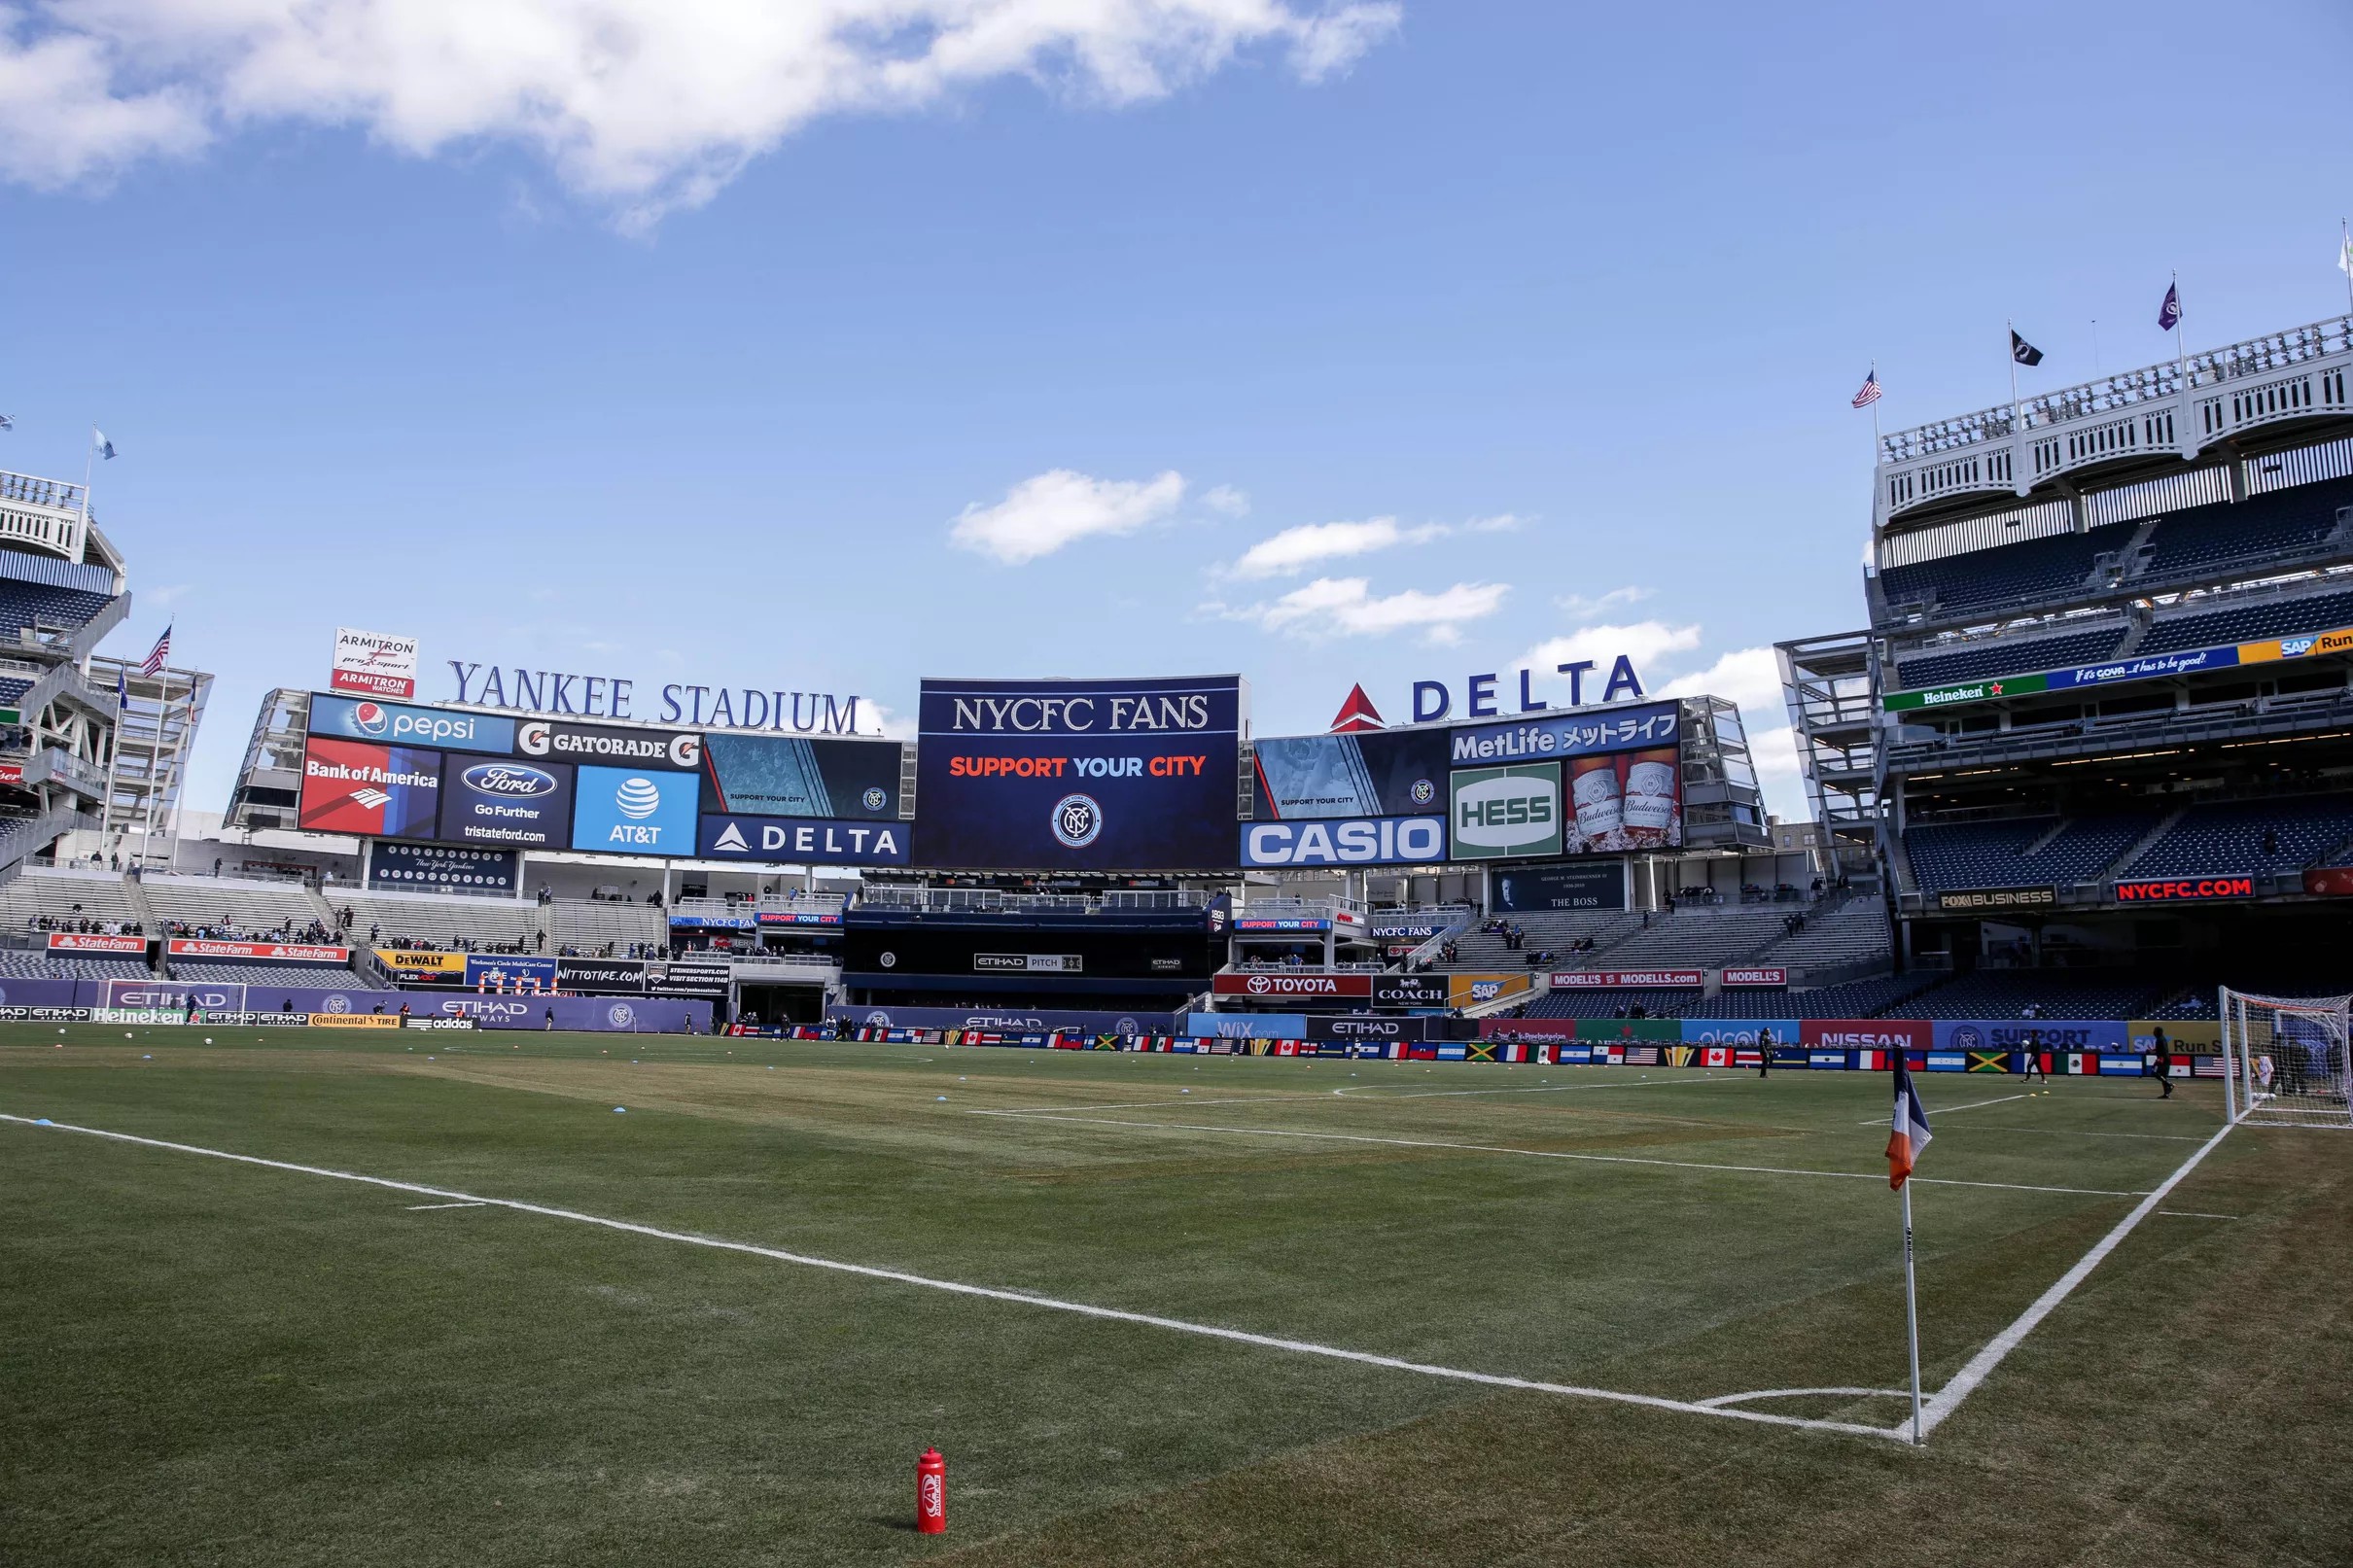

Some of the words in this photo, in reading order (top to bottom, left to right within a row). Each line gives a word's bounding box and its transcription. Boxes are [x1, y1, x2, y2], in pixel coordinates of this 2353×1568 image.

[340, 636, 413, 653] ARMITRON
[2281, 640, 2311, 655] SAP
[2322, 636, 2353, 648] Run
[2140, 660, 2156, 672] has
[2158, 661, 2166, 670] to
[2167, 656, 2177, 668] be
[339, 673, 405, 688] ARMITRON
[1413, 654, 1643, 722] DELTA
[372, 684, 404, 694] WATCHES
[1923, 684, 1983, 705] Heineken
[447, 660, 633, 719] YANKEE
[660, 683, 860, 735] STADIUM
[953, 698, 1094, 730] NYCFC
[1109, 695, 1209, 729] FANS
[393, 714, 474, 742] pepsi
[1563, 714, 1676, 749] メットライフ
[553, 734, 666, 758] GATORADE
[1453, 727, 1556, 760] MetLife
[949, 756, 1068, 778] SUPPORT
[1072, 757, 1142, 778] YOUR
[1149, 755, 1206, 776] CITY
[306, 761, 351, 780] Bank
[352, 769, 369, 782] of
[369, 768, 438, 788] America
[480, 768, 537, 794] Ford
[730, 793, 763, 802] SUPPORT
[1337, 796, 1353, 805] CITY
[474, 804, 493, 816] Go
[495, 806, 540, 819] Further
[1461, 795, 1551, 827] HESS
[465, 826, 545, 843] tristateford.com
[610, 825, 661, 844] AT&T
[762, 826, 897, 854] DELTA
[1248, 819, 1441, 863] CASIO
[447, 861, 474, 871] Yankees
[2119, 879, 2252, 900] NYCFC.COM
[1551, 898, 1570, 907] THE
[1573, 897, 1598, 906] BOSS
[1972, 891, 2053, 905] BUSINESS
[702, 918, 736, 926] NYCFC
[1373, 927, 1406, 936] NYCFC
[1408, 926, 1432, 936] FANS
[977, 958, 1024, 966] ETIHAD
[1032, 958, 1058, 967] PITCH
[557, 967, 643, 984] NITTOTIRE.COM
[1555, 975, 1601, 985] MODELL'S
[1620, 973, 1697, 984] MODELLS.com
[1727, 971, 1780, 982] MODELL'S
[1274, 978, 1337, 993] TOYOTA
[1472, 984, 1498, 998] SAP
[1378, 990, 1443, 1000] COACH
[32, 1008, 88, 1017] ETIHAD
[442, 1001, 527, 1014] ETIHAD
[92, 1008, 184, 1024] Heineken
[312, 1014, 367, 1026] Continental
[433, 1018, 473, 1028] adidas
[966, 1017, 1042, 1028] ETIHAD
[1332, 1023, 1399, 1034] ETIHAD
[1991, 1028, 2091, 1044] SUPPORT
[1821, 1032, 1911, 1047] NISSAN
[2133, 1038, 2157, 1052] SA
[2174, 1039, 2206, 1052] Run
